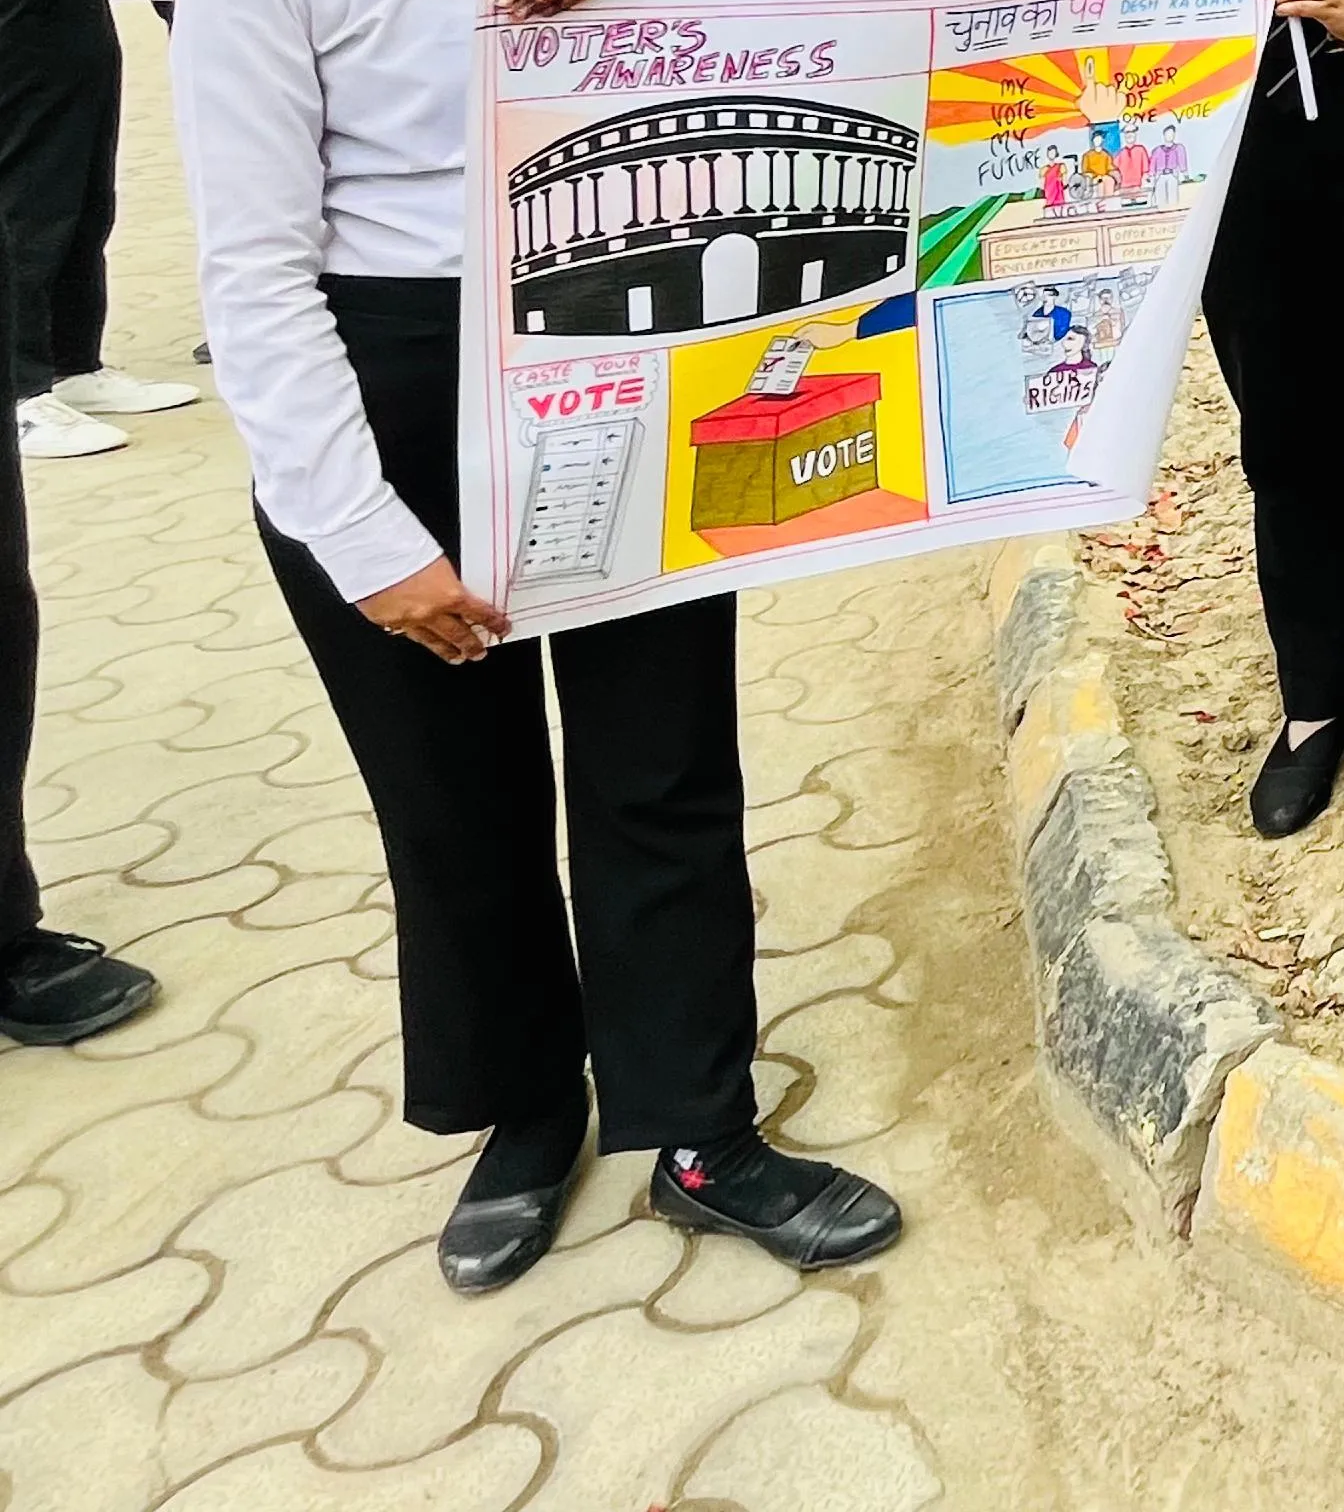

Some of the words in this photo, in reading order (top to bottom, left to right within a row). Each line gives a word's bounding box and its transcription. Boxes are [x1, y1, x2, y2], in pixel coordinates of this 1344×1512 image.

[945, 3, 1022, 52] चुनाव
[500, 20, 708, 72] VOTER'S
[573, 40, 838, 93] AWARENESS
[1114, 66, 1178, 92] POWER
[1000, 76, 1030, 97] MY
[990, 99, 1036, 128] VOTE
[1122, 109, 1158, 125] ONE
[1169, 101, 1213, 125] VOTE
[989, 128, 1029, 157] MY
[977, 144, 1041, 186] FUTURE
[1052, 201, 1107, 218] VOTE
[512, 361, 574, 387] CASTE
[589, 355, 642, 375] YOUR
[527, 377, 645, 420] VOTE
[789, 431, 876, 486] VOTE
